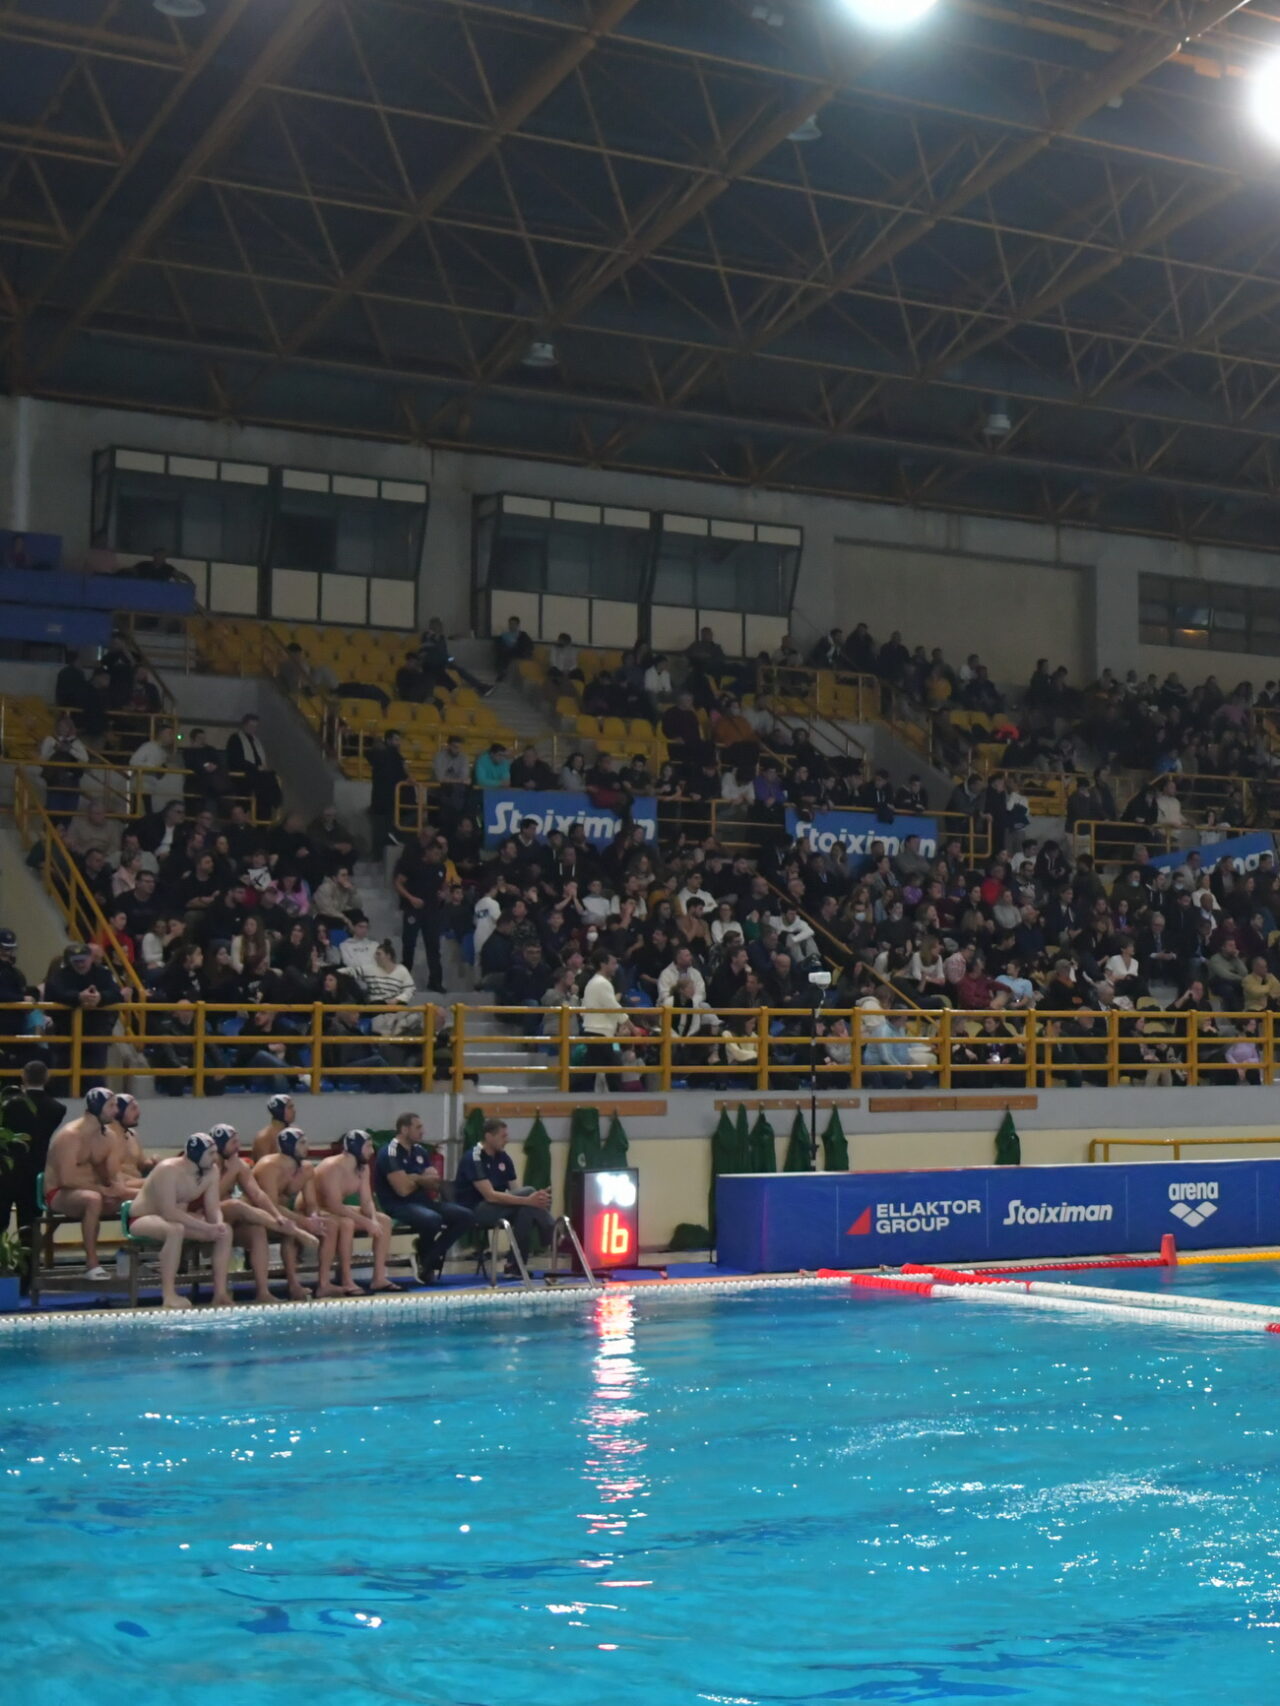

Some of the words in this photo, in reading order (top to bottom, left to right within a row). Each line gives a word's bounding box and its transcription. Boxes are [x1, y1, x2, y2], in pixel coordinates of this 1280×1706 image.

[488, 802, 655, 840] Stoiximn
[793, 821, 936, 858] Stoiximn
[1168, 1181, 1219, 1201] arena
[876, 1199, 981, 1218] ELLAKTOR
[1003, 1199, 1113, 1226] Stoiximan
[601, 1212, 629, 1254] 16
[876, 1216, 950, 1234] GROUP
